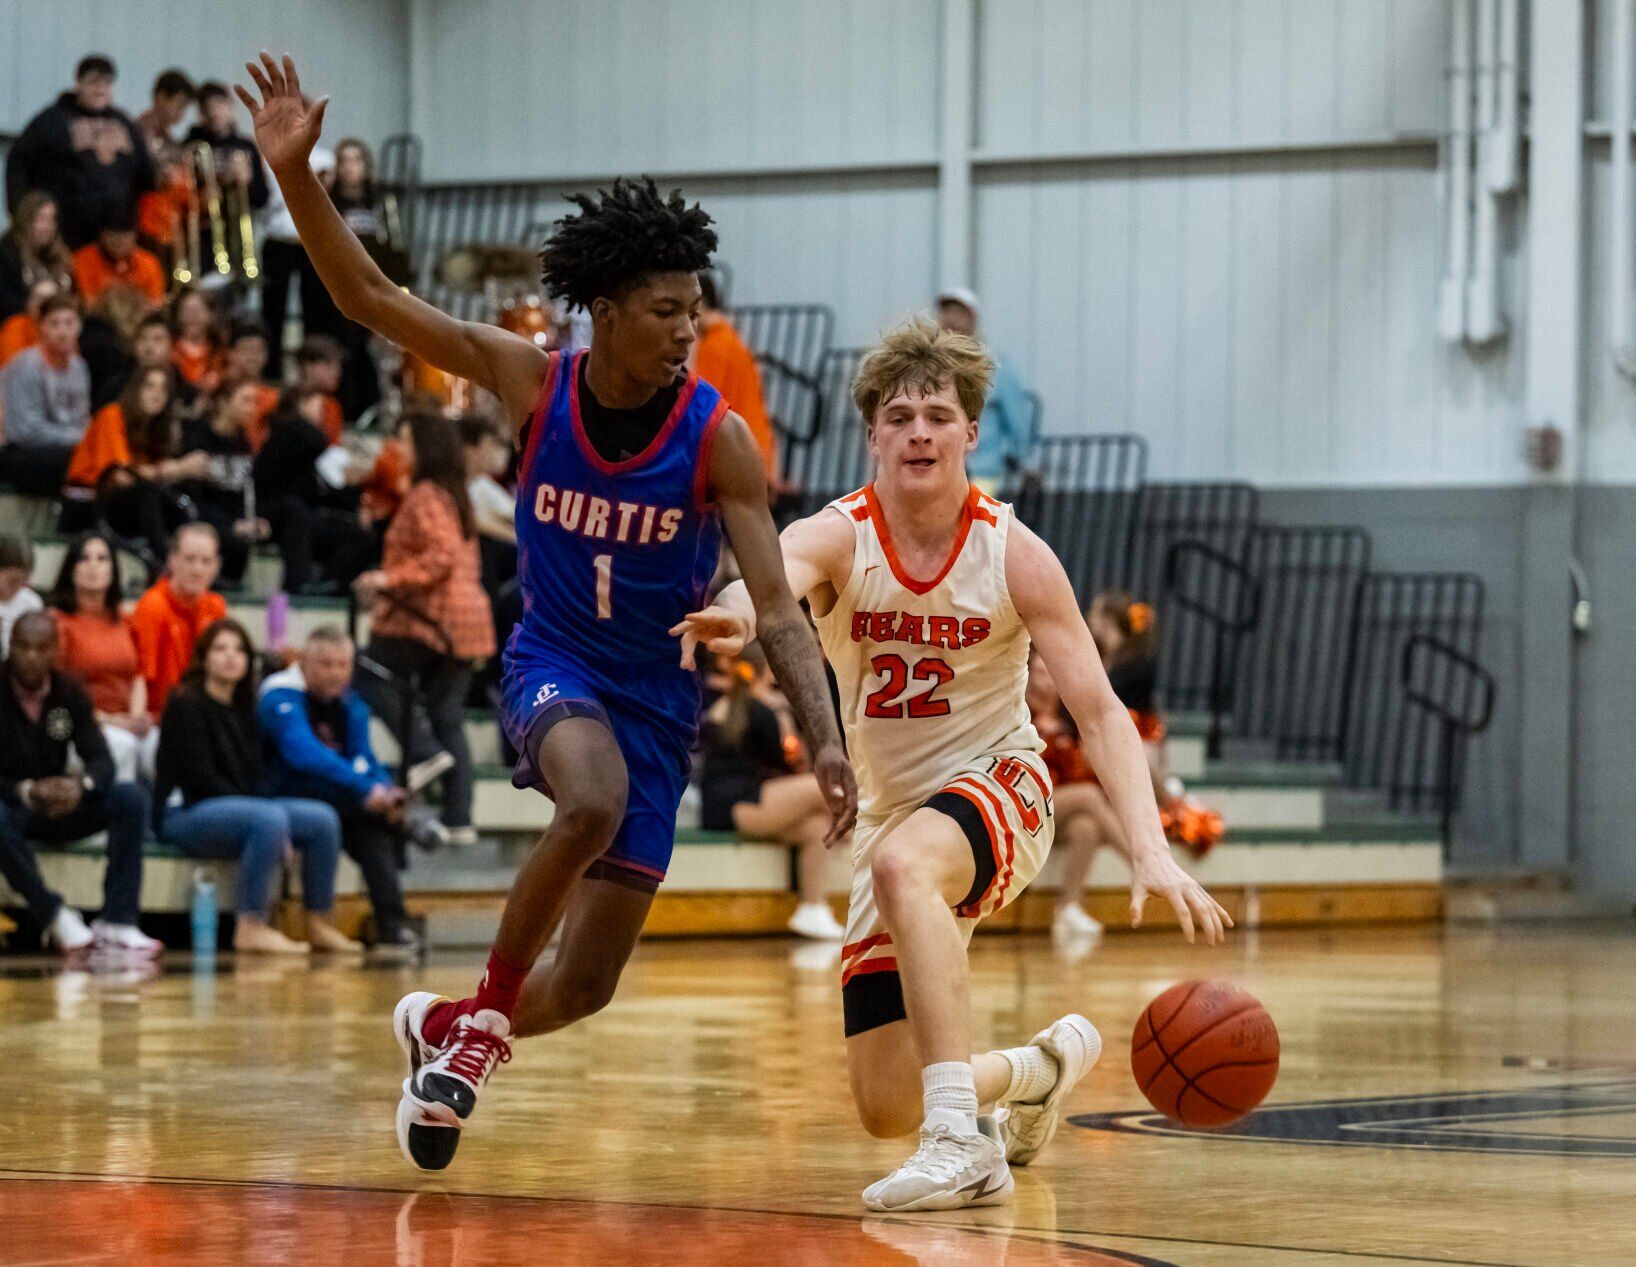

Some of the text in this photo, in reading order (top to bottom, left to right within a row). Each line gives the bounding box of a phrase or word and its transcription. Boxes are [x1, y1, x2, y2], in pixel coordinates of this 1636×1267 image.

[533, 482, 684, 545] CURTIS
[592, 553, 614, 620] 1
[864, 652, 955, 719] 22
